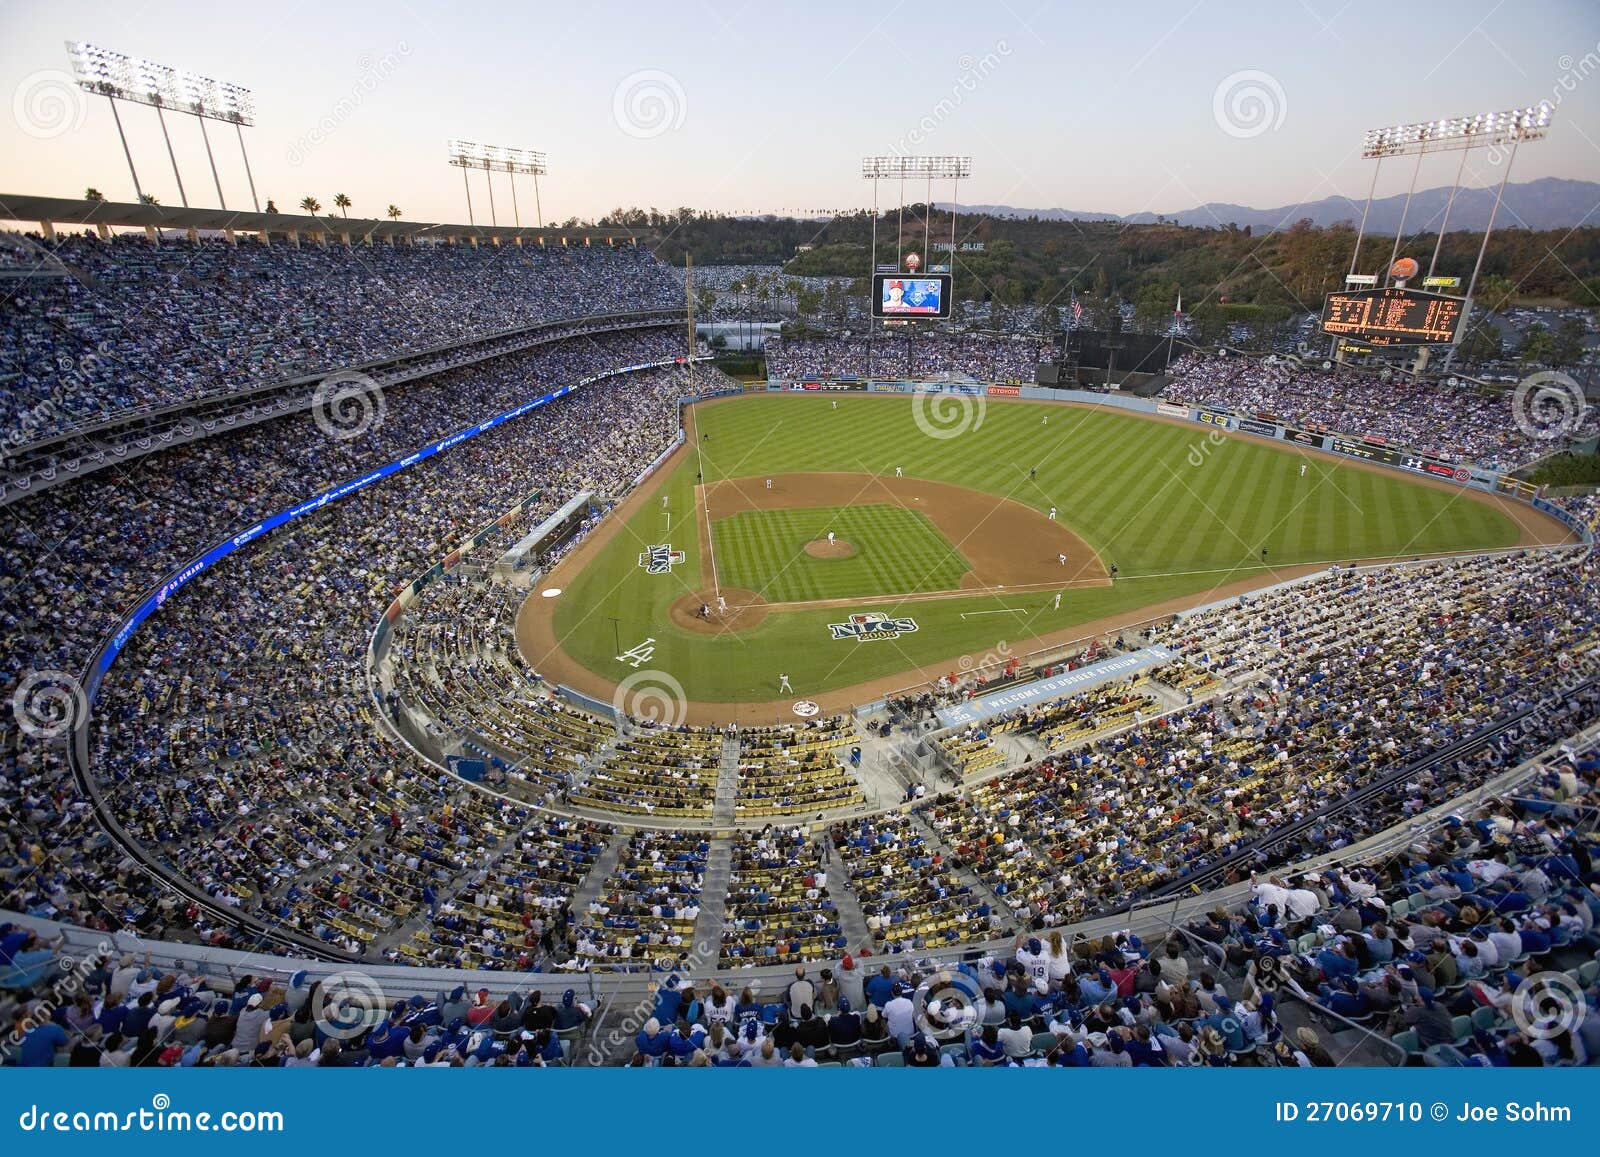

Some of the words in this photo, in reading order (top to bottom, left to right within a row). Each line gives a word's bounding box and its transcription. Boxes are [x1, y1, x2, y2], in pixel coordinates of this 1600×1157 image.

[933, 243, 956, 251] THINK
[962, 243, 985, 251] BLUE
[1456, 471, 1469, 479] 76
[179, 561, 204, 582] DEMAND
[828, 618, 918, 640] NLCS
[859, 631, 896, 640] 2008
[988, 688, 1041, 708] WELCOME
[1041, 683, 1056, 691] TO
[1057, 671, 1097, 687] DODGER
[1095, 657, 1138, 675] STADIUM
[1033, 966, 1044, 977] 19
